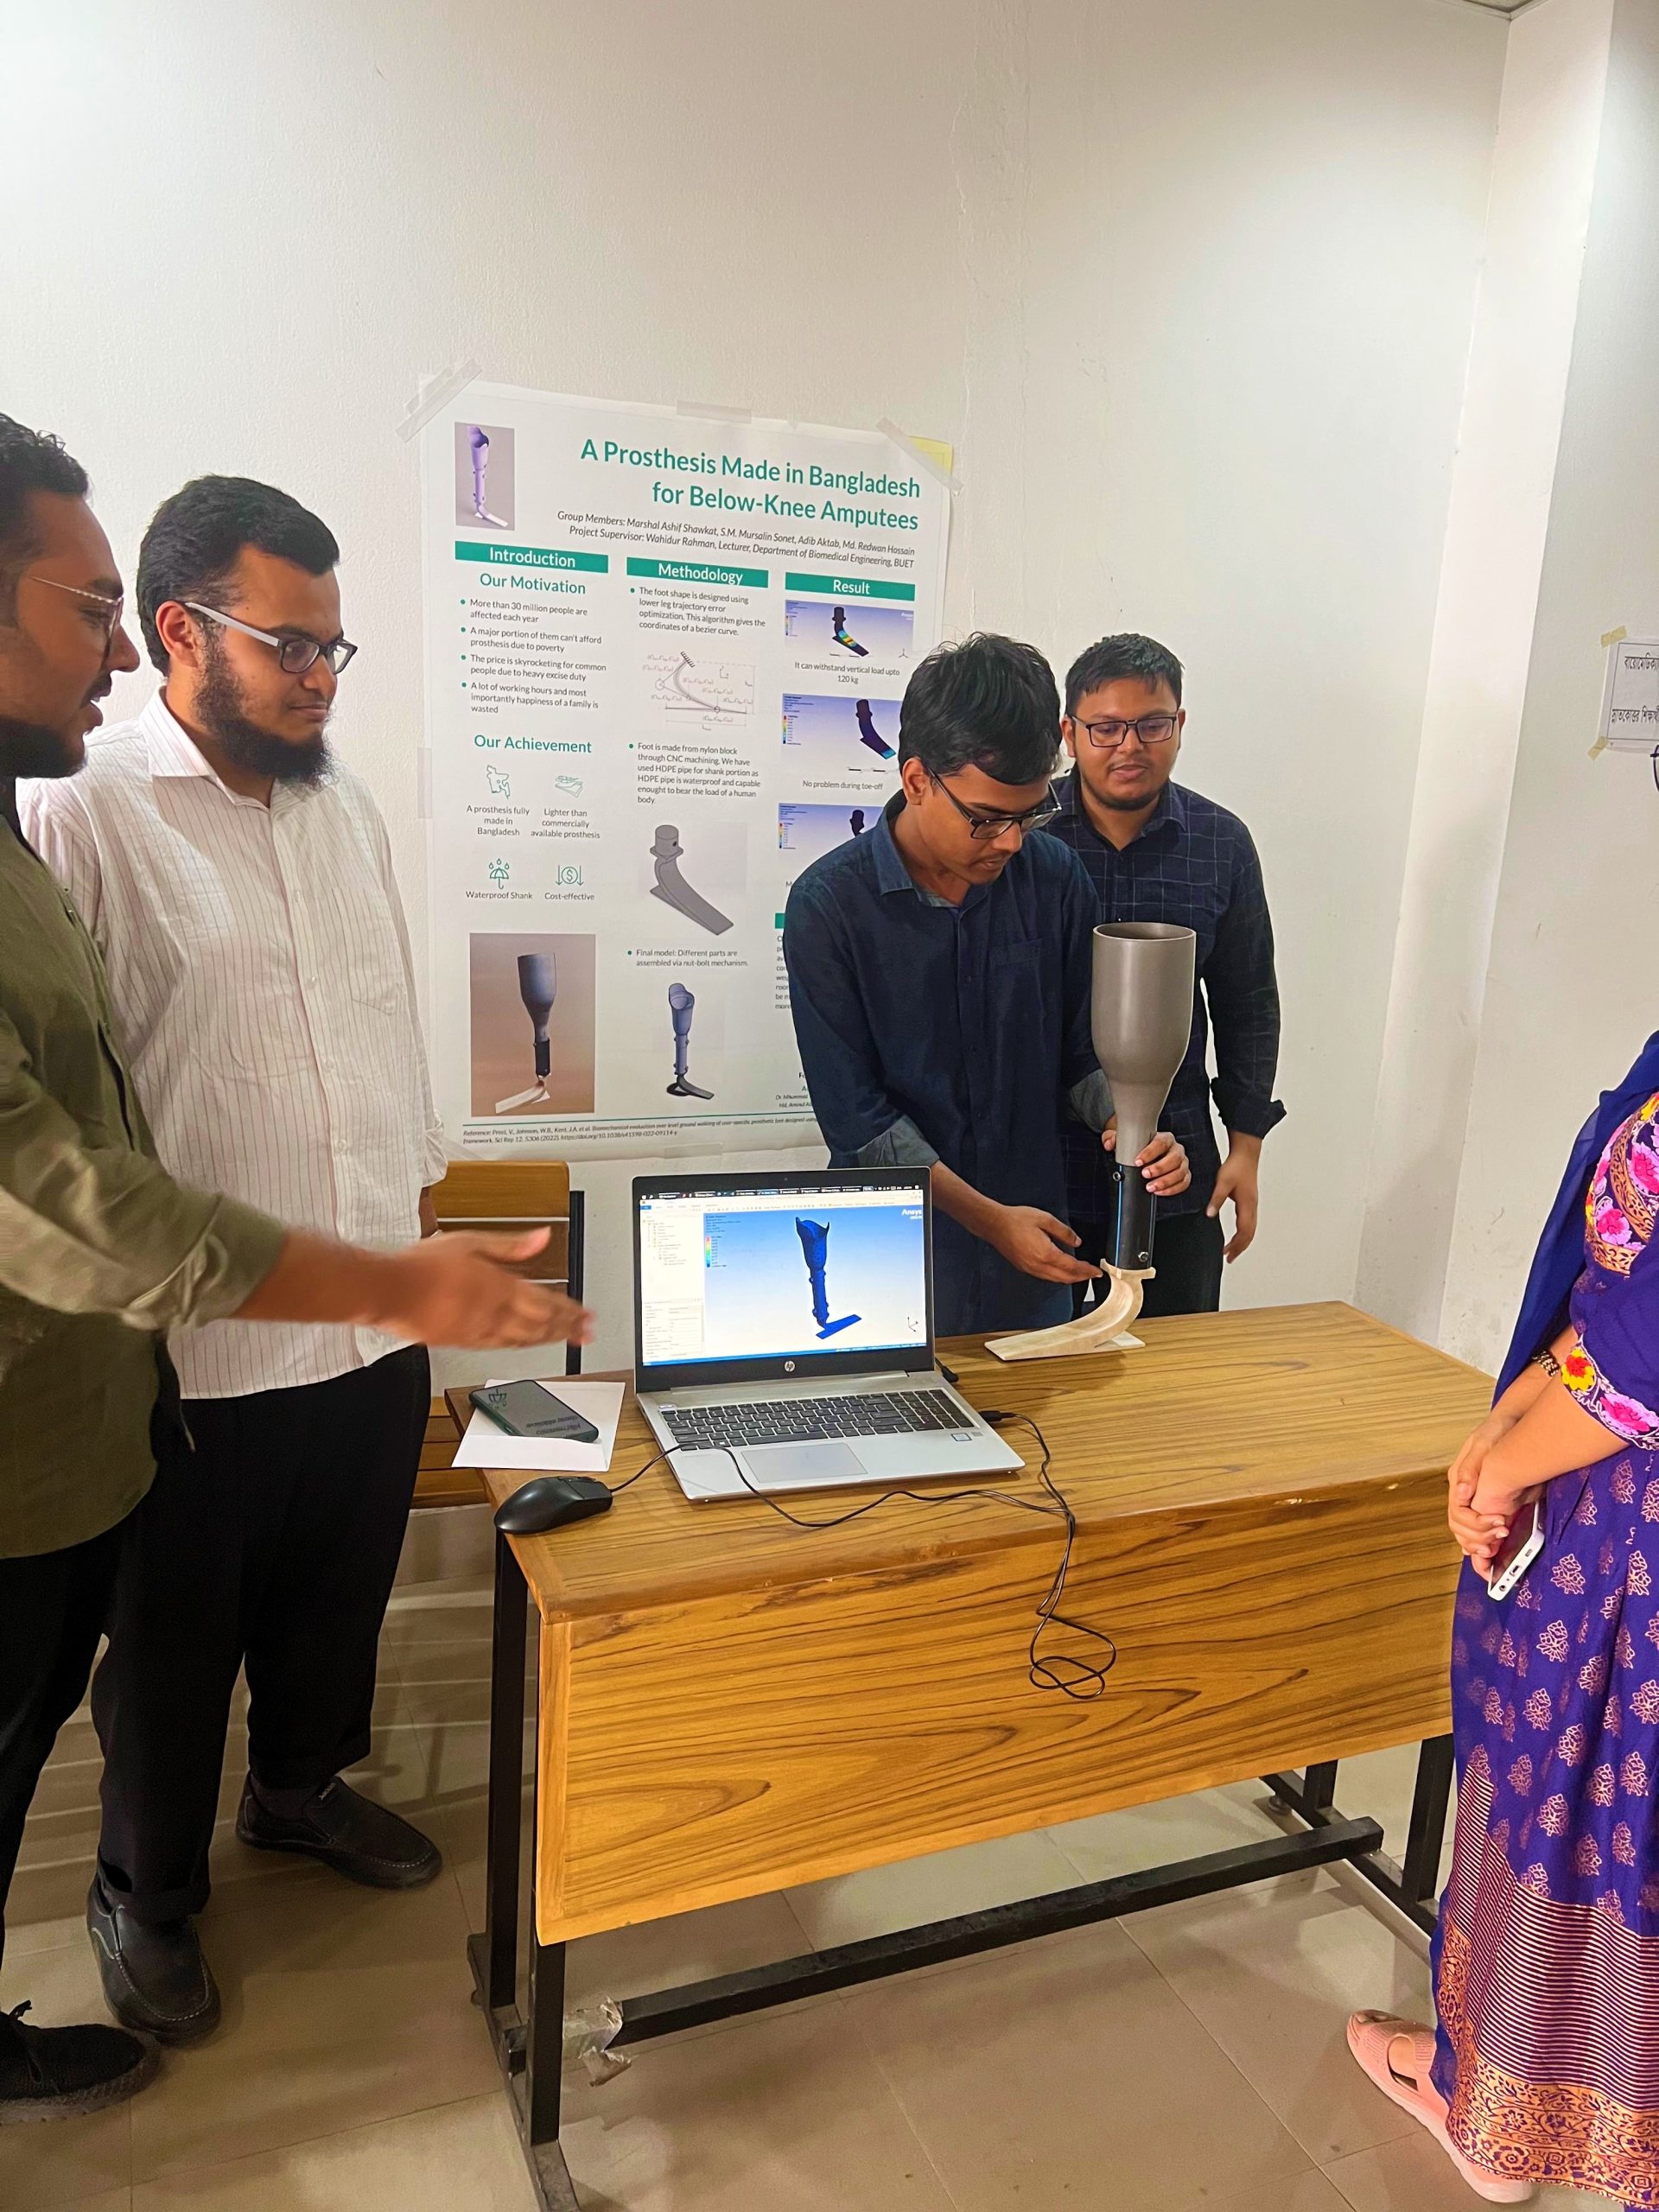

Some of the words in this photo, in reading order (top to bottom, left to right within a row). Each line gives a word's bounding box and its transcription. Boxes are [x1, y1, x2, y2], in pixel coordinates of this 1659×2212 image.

[581, 438, 598, 461] A
[604, 441, 716, 474] Prosthesis
[721, 454, 780, 481] Made
[785, 462, 804, 484] in
[809, 465, 920, 499] Bangladesh
[652, 480, 683, 505] for
[690, 485, 816, 518] Below-Knee
[820, 499, 918, 530] Amputees
[557, 510, 583, 523] Group
[626, 518, 659, 530] Marshal
[660, 520, 682, 532] Ashif
[738, 529, 772, 541] Mursalin
[798, 535, 816, 545] Adib
[857, 541, 886, 552] Redwan
[887, 544, 914, 556] Hossain
[569, 524, 598, 538] Project
[645, 532, 680, 545] Wahidur
[753, 543, 798, 558] Department
[798, 548, 807, 558] of
[808, 549, 849, 562] Biomedical
[893, 557, 914, 569] BUET
[490, 546, 575, 568] Introduction
[658, 563, 743, 585] Methodology
[480, 572, 507, 588] Our
[511, 575, 585, 594] Motivation
[833, 579, 870, 594] Result
[639, 586, 652, 595] The
[654, 588, 669, 596] foot
[670, 589, 690, 600] shape
[698, 592, 729, 603] designed
[730, 596, 748, 605] using
[470, 598, 491, 607] More
[492, 601, 510, 609] than
[511, 601, 521, 610] 30
[522, 602, 548, 613] million
[549, 605, 574, 616] people
[639, 598, 659, 607] lower
[660, 600, 671, 609] leg
[672, 601, 707, 612] trajectory
[470, 609, 501, 620] affected
[502, 613, 521, 621] each
[522, 615, 538, 624] year
[686, 613, 700, 621] This
[702, 614, 734, 626] algorithm
[735, 619, 753, 627] gives
[478, 626, 499, 638] major
[501, 629, 529, 639] portion
[539, 632, 559, 640] them
[579, 634, 601, 644] afford
[470, 638, 509, 649] prosthesis
[510, 640, 524, 649] due
[536, 644, 564, 653] poverty
[470, 653, 485, 662] The
[486, 656, 505, 665] price
[514, 657, 562, 670] skyrocketing
[563, 660, 574, 669] for
[575, 663, 607, 671] common
[813, 662, 845, 671] withstand
[846, 664, 870, 673] vertical
[885, 668, 899, 677] upto
[470, 665, 496, 676] people
[497, 667, 512, 676] due
[522, 669, 544, 679] heavy
[545, 671, 568, 679] excise
[569, 671, 586, 682] duty
[850, 676, 858, 684] kg
[478, 682, 488, 690] lot
[499, 683, 530, 694] working
[531, 685, 552, 695] hours
[553, 687, 567, 696] and
[471, 704, 498, 713] wasted
[474, 734, 500, 747] Our
[504, 735, 591, 753] Achievement
[638, 741, 653, 750] Foot
[661, 743, 681, 752] made
[699, 746, 718, 754] nylon
[638, 753, 665, 763] through
[655, 764, 677, 772] HDPE
[704, 766, 724, 775] shank
[813, 780, 839, 789] problem
[840, 781, 861, 790] during
[474, 805, 512, 815] prosthesis
[513, 806, 530, 816] fully
[543, 808, 569, 817] Lighter
[541, 819, 589, 828] commercially
[477, 827, 519, 836] Bangladesh
[531, 829, 562, 837] available
[563, 830, 600, 839] prosthesis
